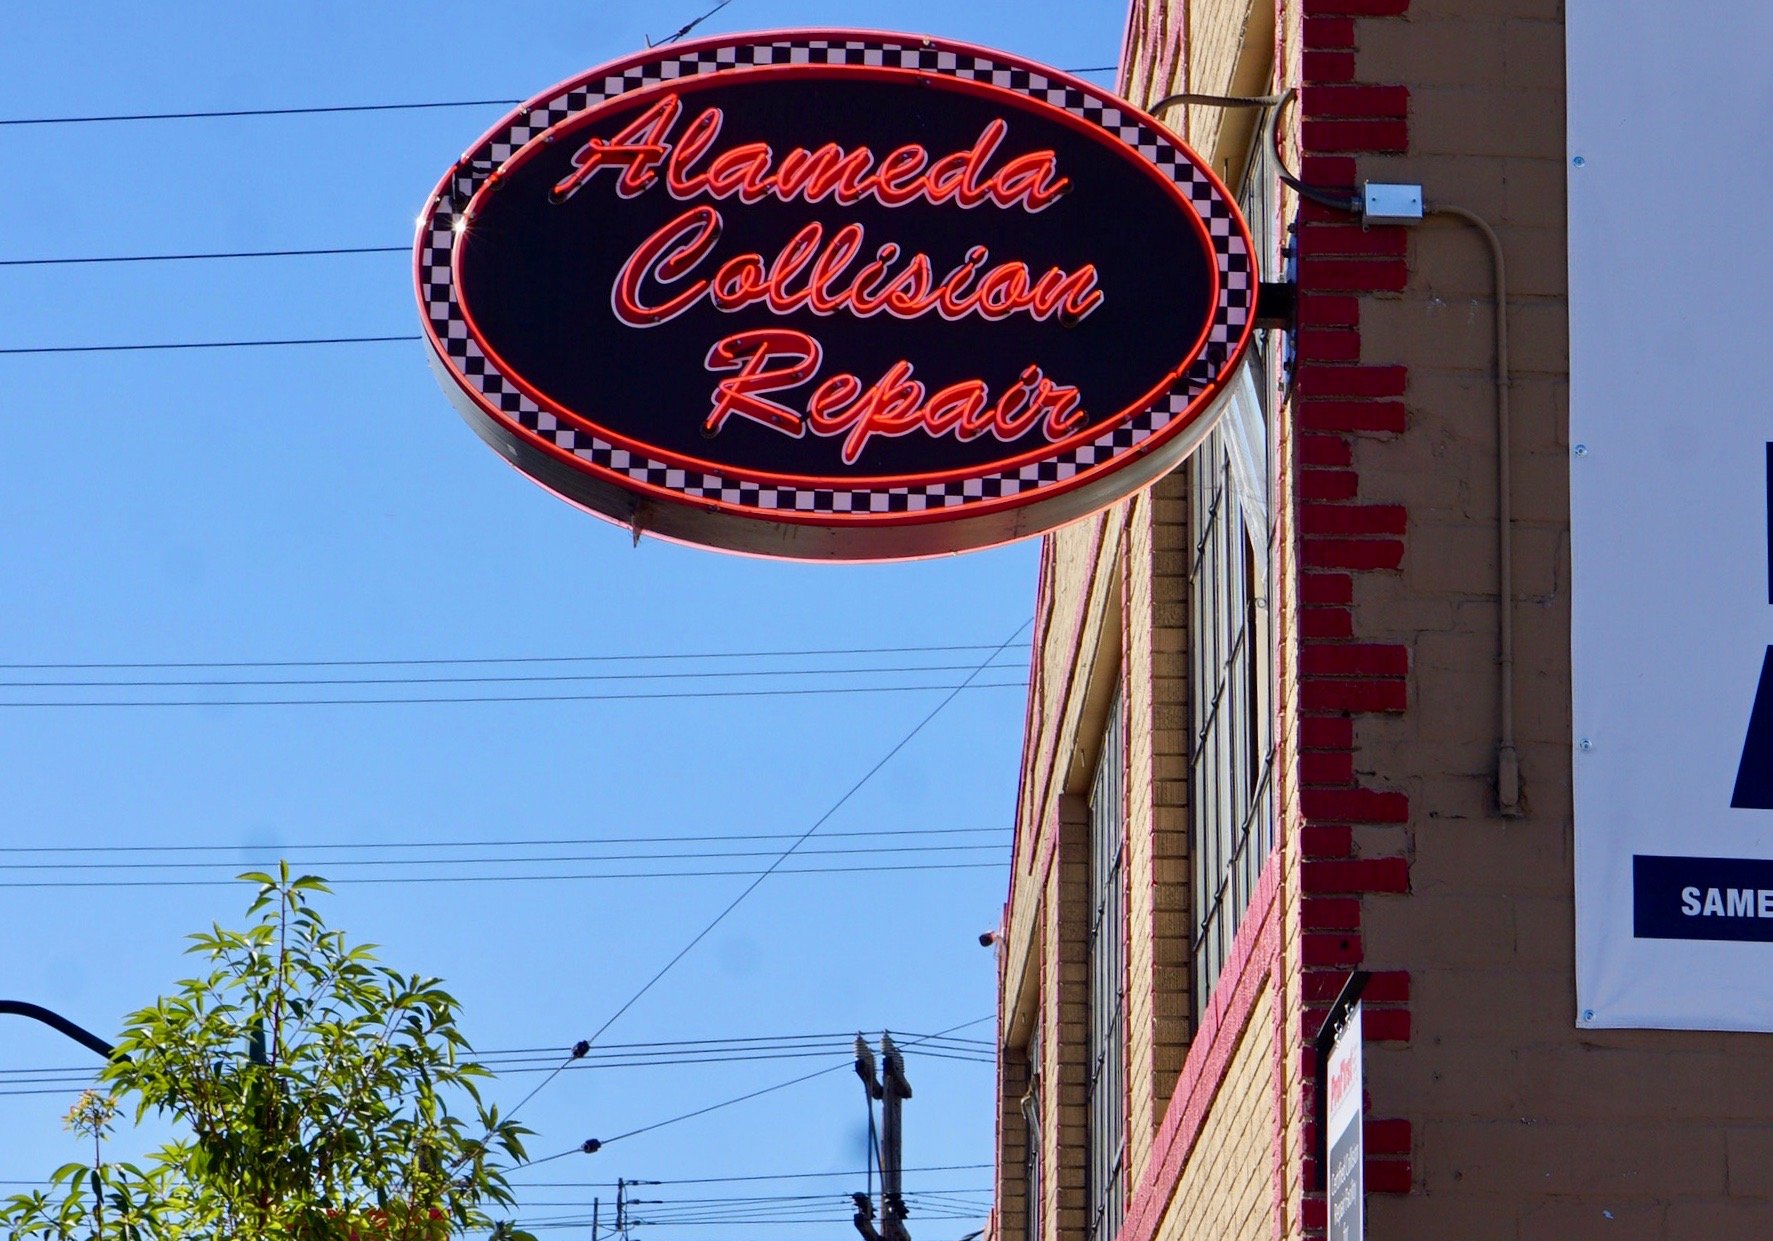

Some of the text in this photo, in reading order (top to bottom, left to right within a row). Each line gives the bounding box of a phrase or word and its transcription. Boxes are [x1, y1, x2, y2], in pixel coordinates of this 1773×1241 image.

[546, 92, 1074, 213] Alameda
[611, 205, 1105, 329] Collision
[699, 328, 1090, 465] Repair
[1681, 886, 1773, 919] SAME
